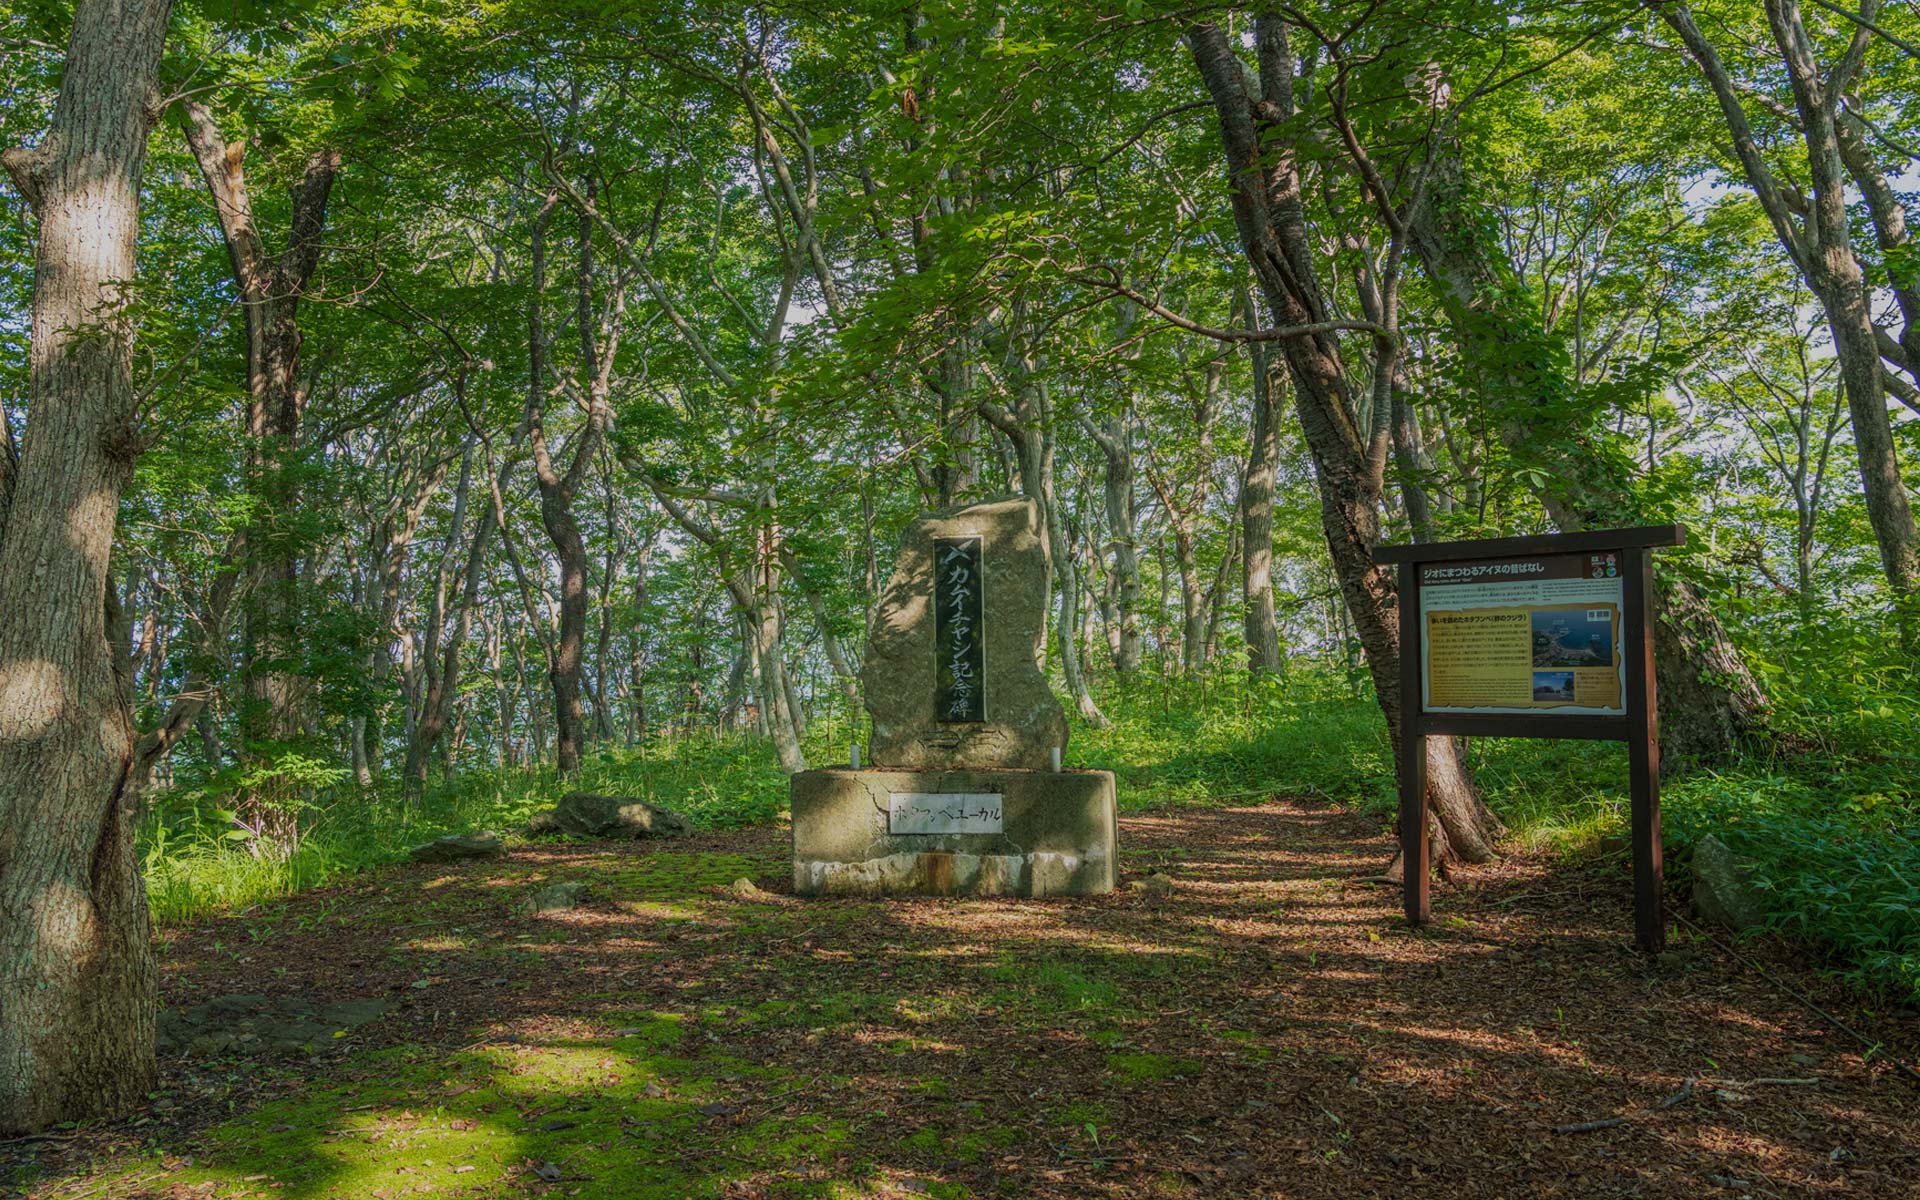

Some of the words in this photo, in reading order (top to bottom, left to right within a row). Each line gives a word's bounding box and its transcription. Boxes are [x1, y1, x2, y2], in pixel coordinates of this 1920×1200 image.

[1424, 562, 1545, 579] ジオにまつわるアイヌの昔ばなし
